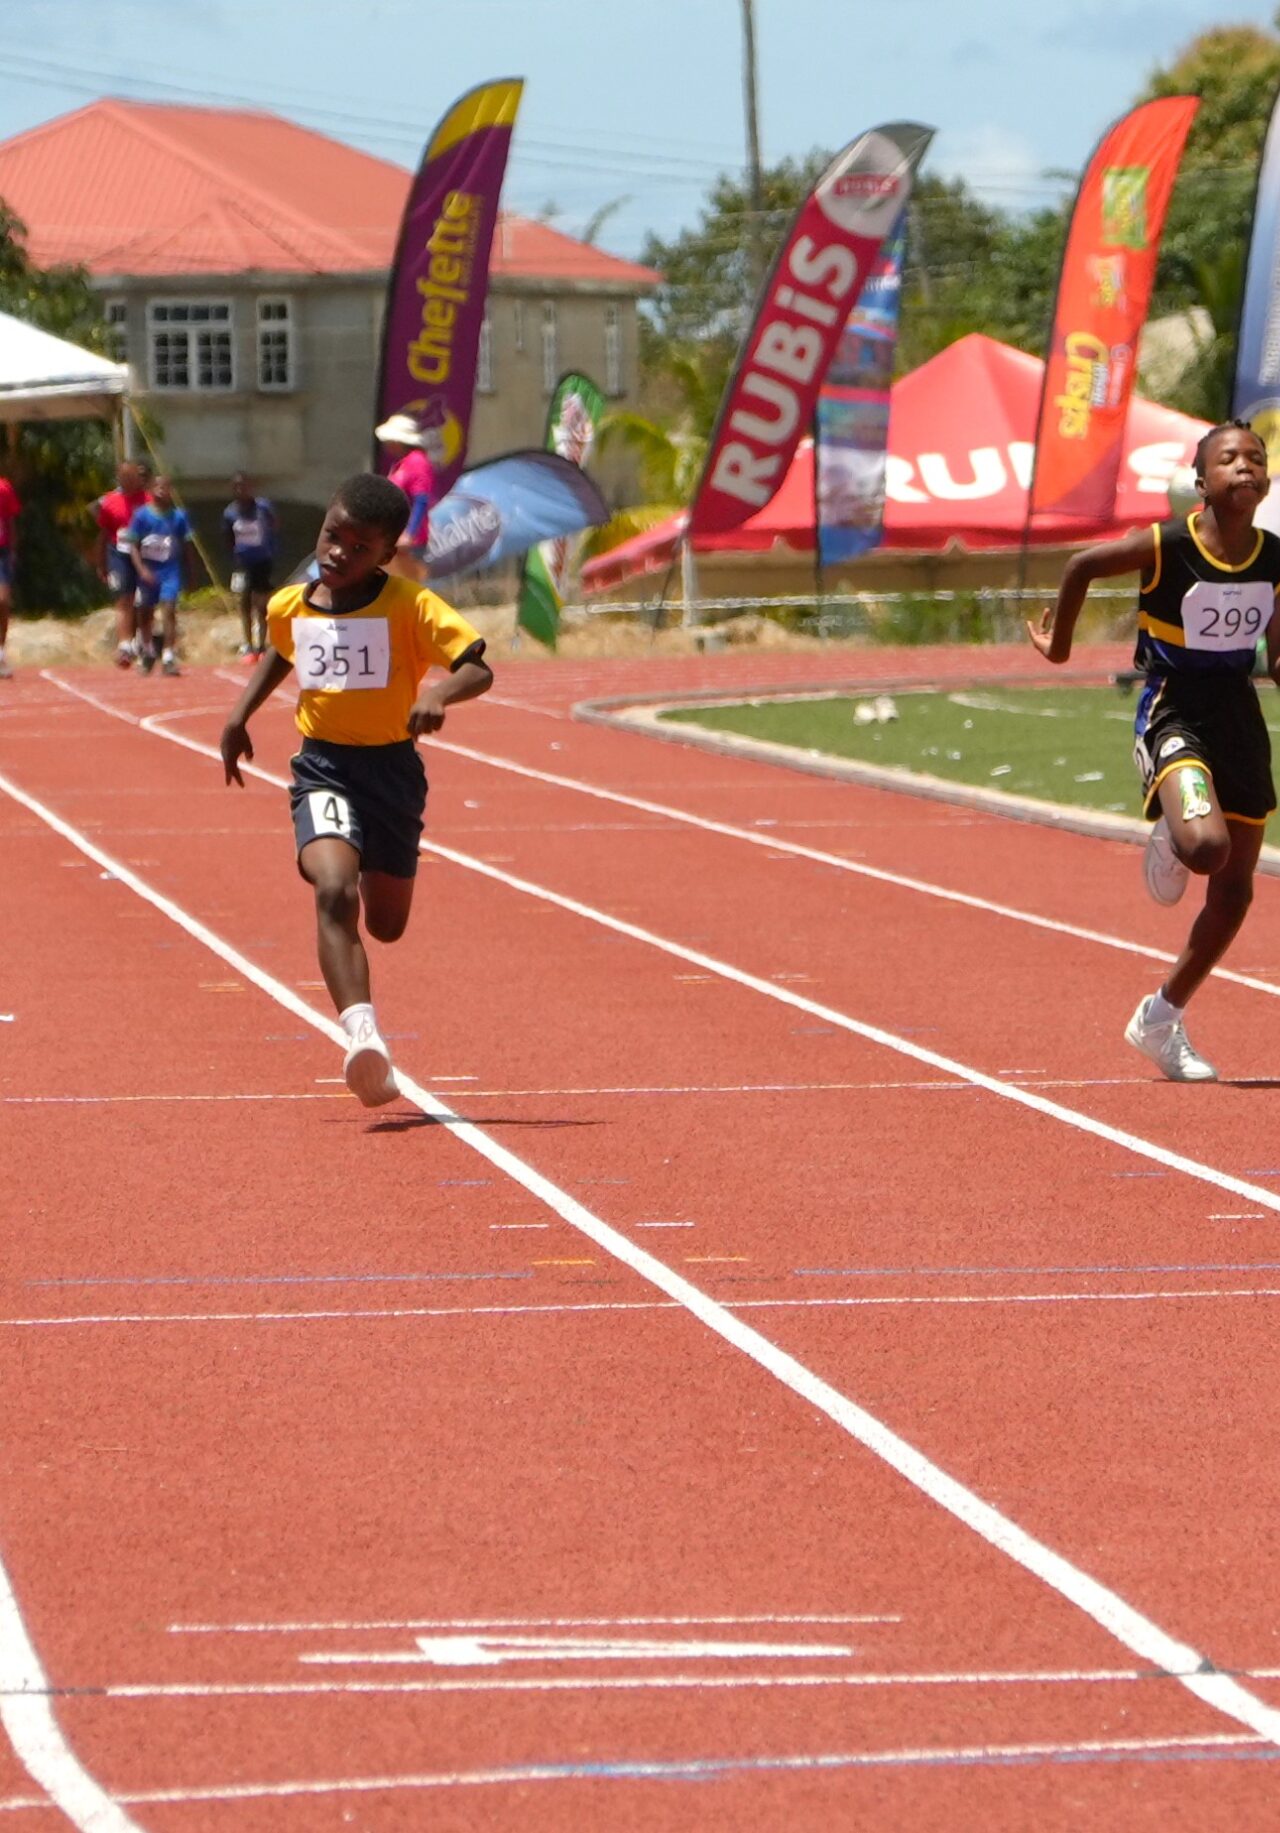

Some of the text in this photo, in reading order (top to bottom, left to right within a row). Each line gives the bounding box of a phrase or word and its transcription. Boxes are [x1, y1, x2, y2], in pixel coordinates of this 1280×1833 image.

[407, 190, 473, 385] Chefette
[1200, 607, 1262, 638] 299
[309, 645, 375, 677] 351
[322, 796, 344, 830] 4
